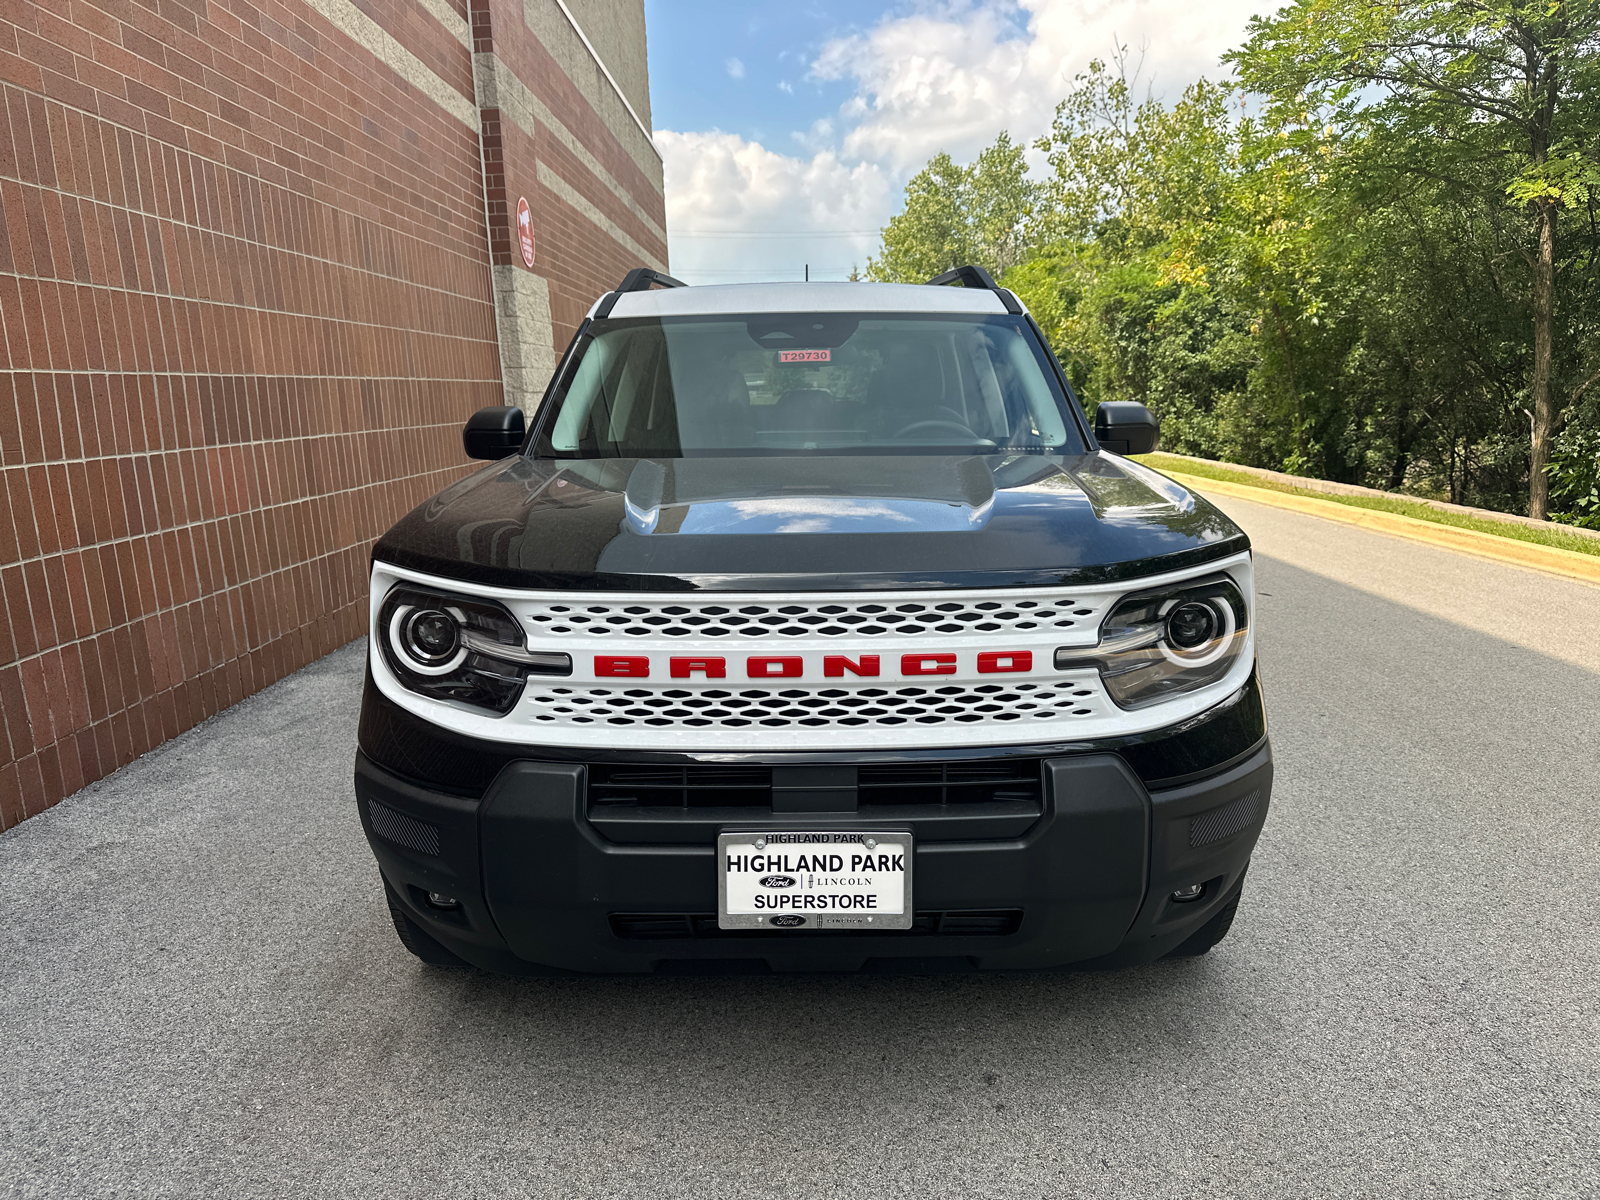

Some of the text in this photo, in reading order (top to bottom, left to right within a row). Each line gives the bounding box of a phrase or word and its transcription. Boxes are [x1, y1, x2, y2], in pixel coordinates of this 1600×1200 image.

[782, 351, 827, 360] T29730
[594, 650, 1033, 678] BRONCO
[765, 834, 864, 843] HIGHLAND PARK
[727, 854, 905, 872] HIGHLAND PARK
[765, 876, 872, 888] Ford LINCOLN
[754, 895, 878, 909] SUPERSTORE
[776, 916, 800, 927] Ford
